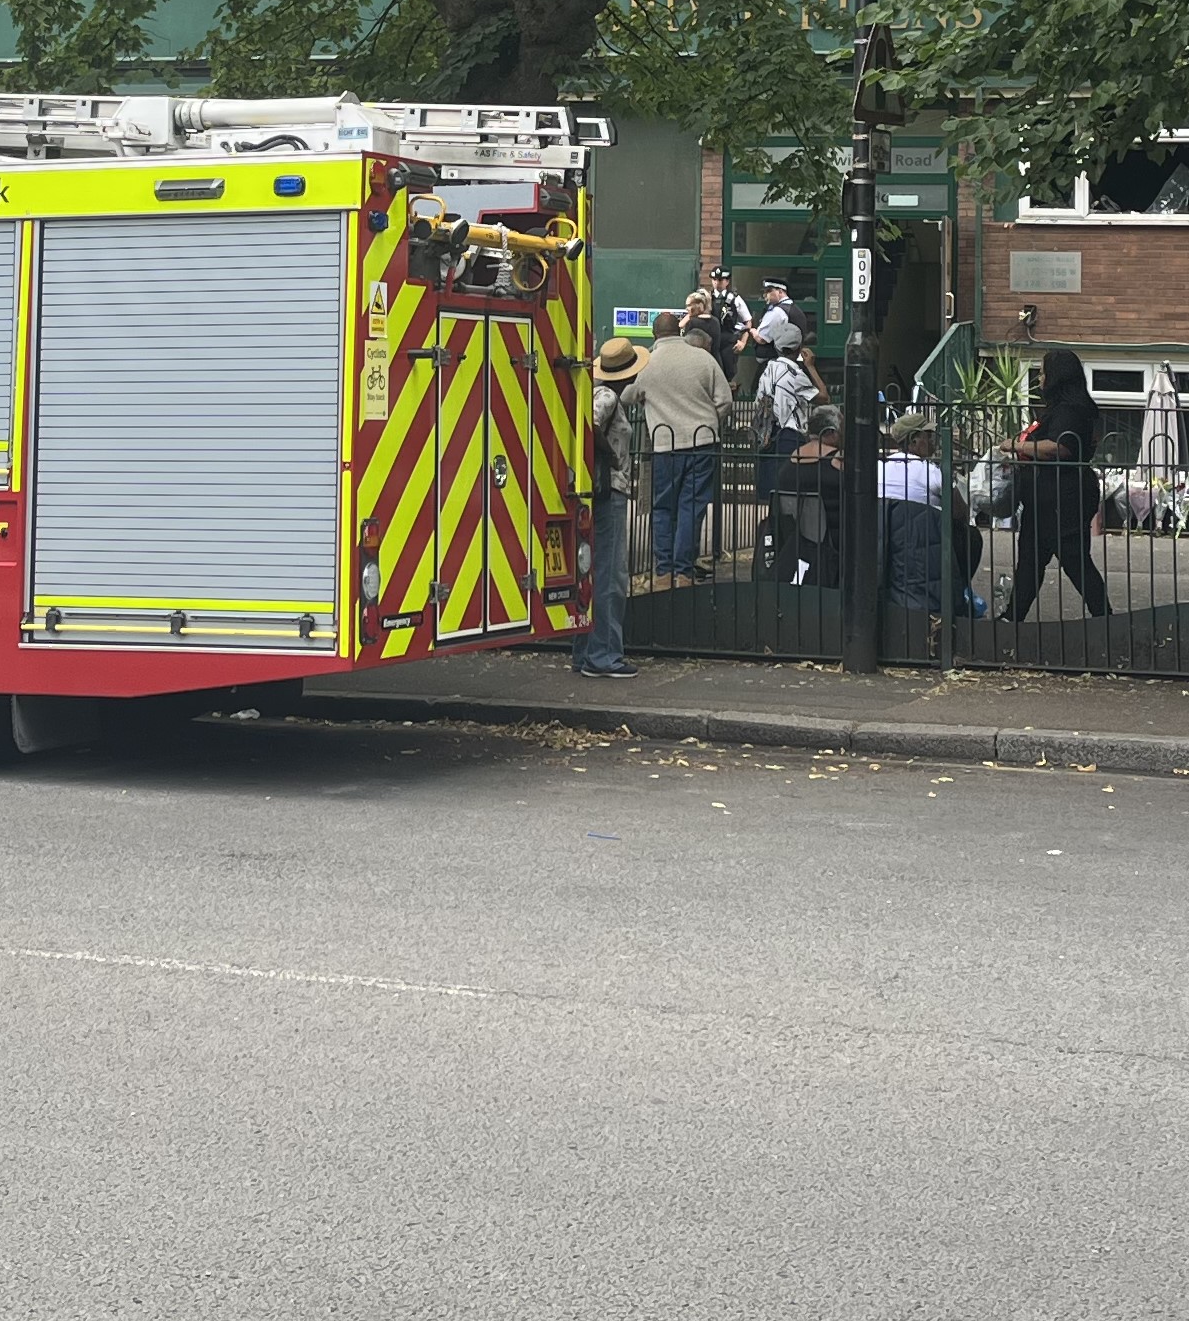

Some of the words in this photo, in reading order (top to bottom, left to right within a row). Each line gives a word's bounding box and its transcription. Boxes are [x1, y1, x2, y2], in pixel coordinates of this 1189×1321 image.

[493, 150, 507, 158] Fire
[518, 151, 542, 162] Safety
[895, 154, 932, 167] Road
[367, 347, 387, 360] Cyclists
[544, 529, 560, 549] P68
